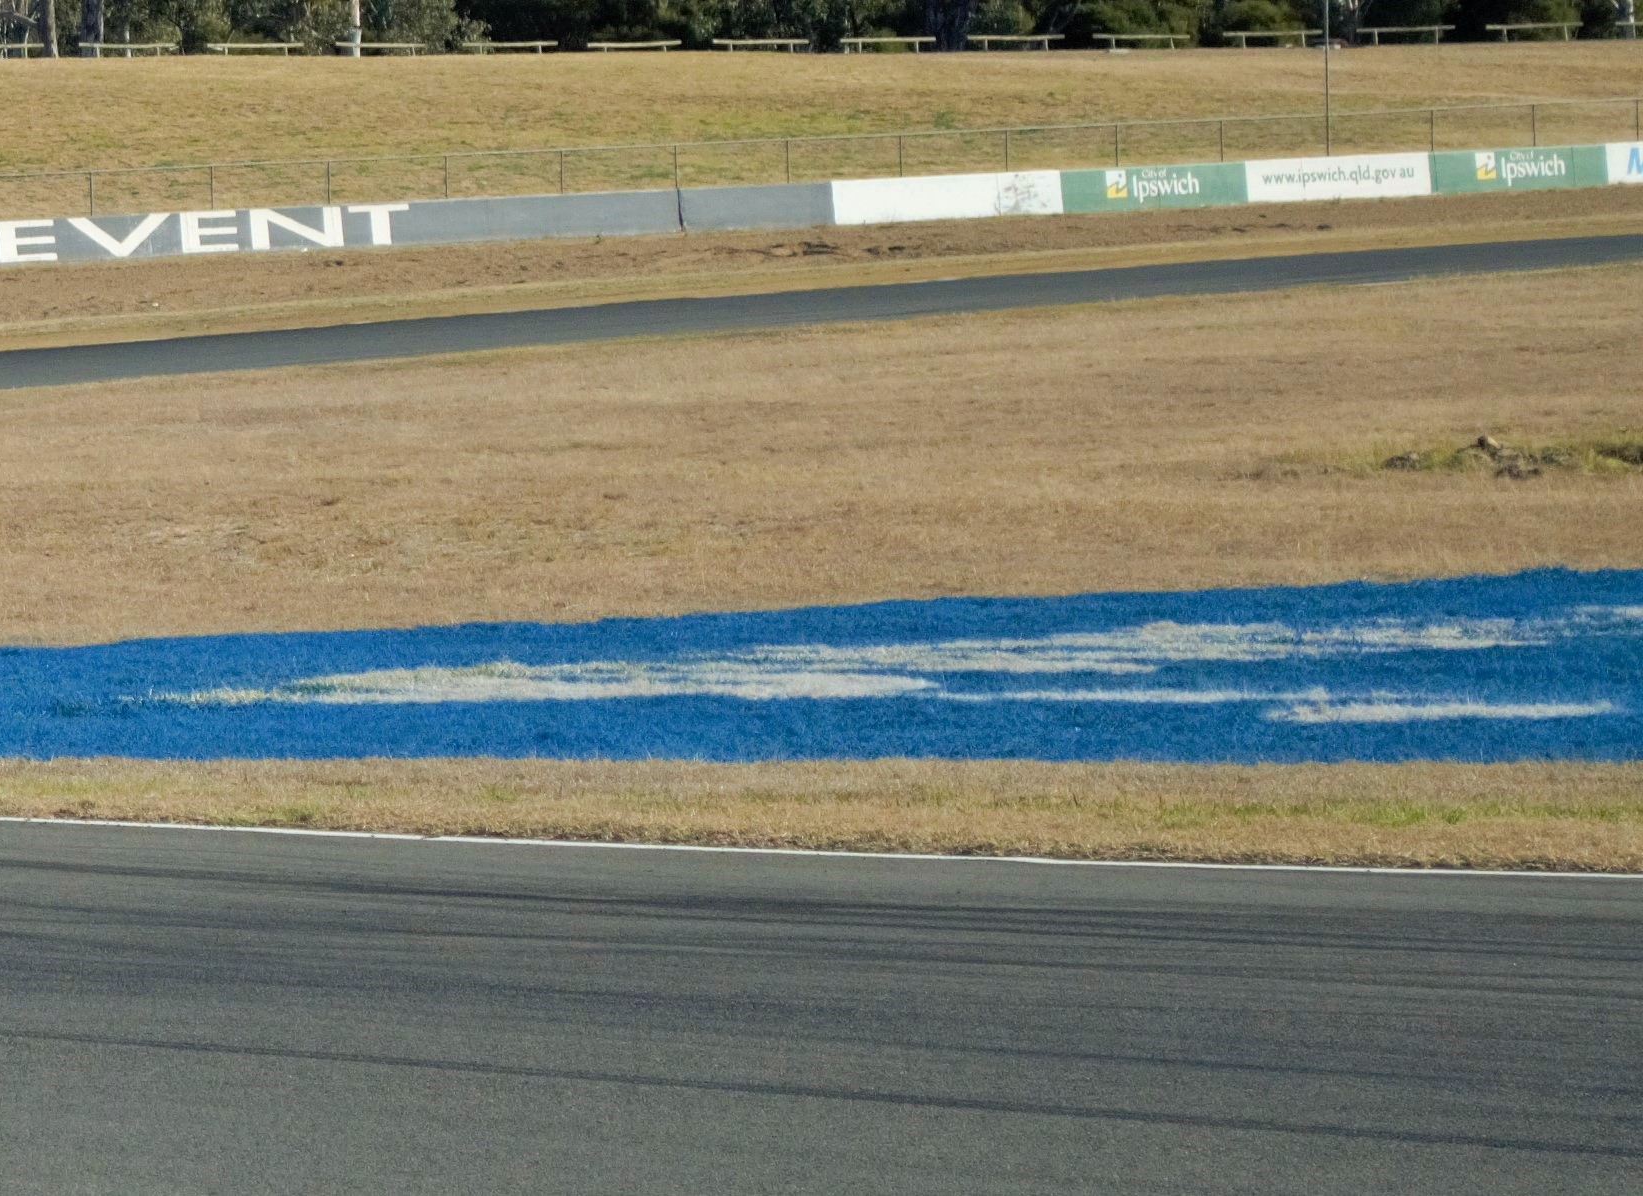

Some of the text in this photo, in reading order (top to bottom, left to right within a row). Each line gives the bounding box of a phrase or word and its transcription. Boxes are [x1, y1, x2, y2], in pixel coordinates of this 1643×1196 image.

[1158, 167, 1167, 177] of
[1262, 164, 1414, 188] www.ipswich.qld.govau
[1501, 153, 1565, 187] Ipswich
[1133, 171, 1200, 204] Ipswich
